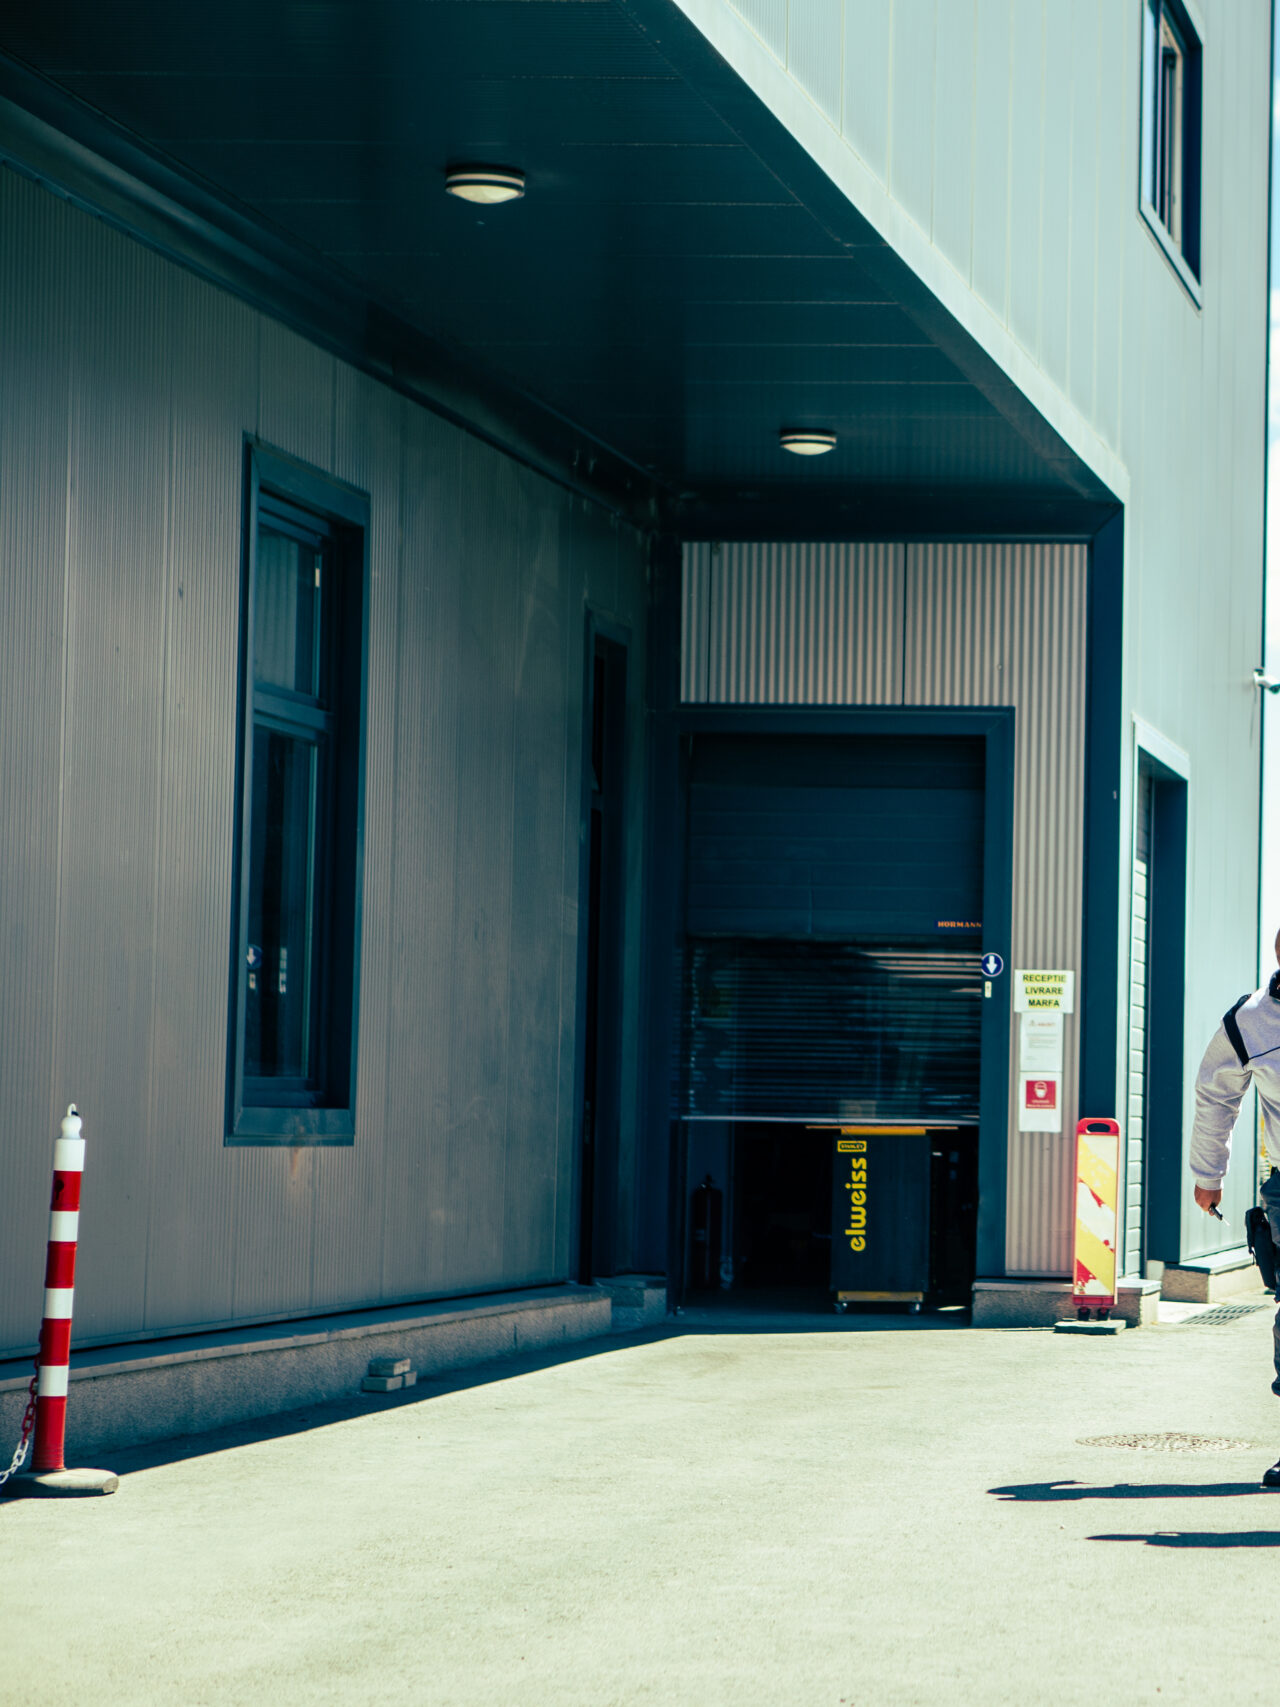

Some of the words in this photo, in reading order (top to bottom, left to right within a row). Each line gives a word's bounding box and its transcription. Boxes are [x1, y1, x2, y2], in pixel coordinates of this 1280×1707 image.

[1022, 974, 1066, 982] RECEPTIE
[1025, 986, 1063, 995] LIVRARE
[1028, 999, 1060, 1007] MARFA
[845, 1157, 867, 1252] elweiss
